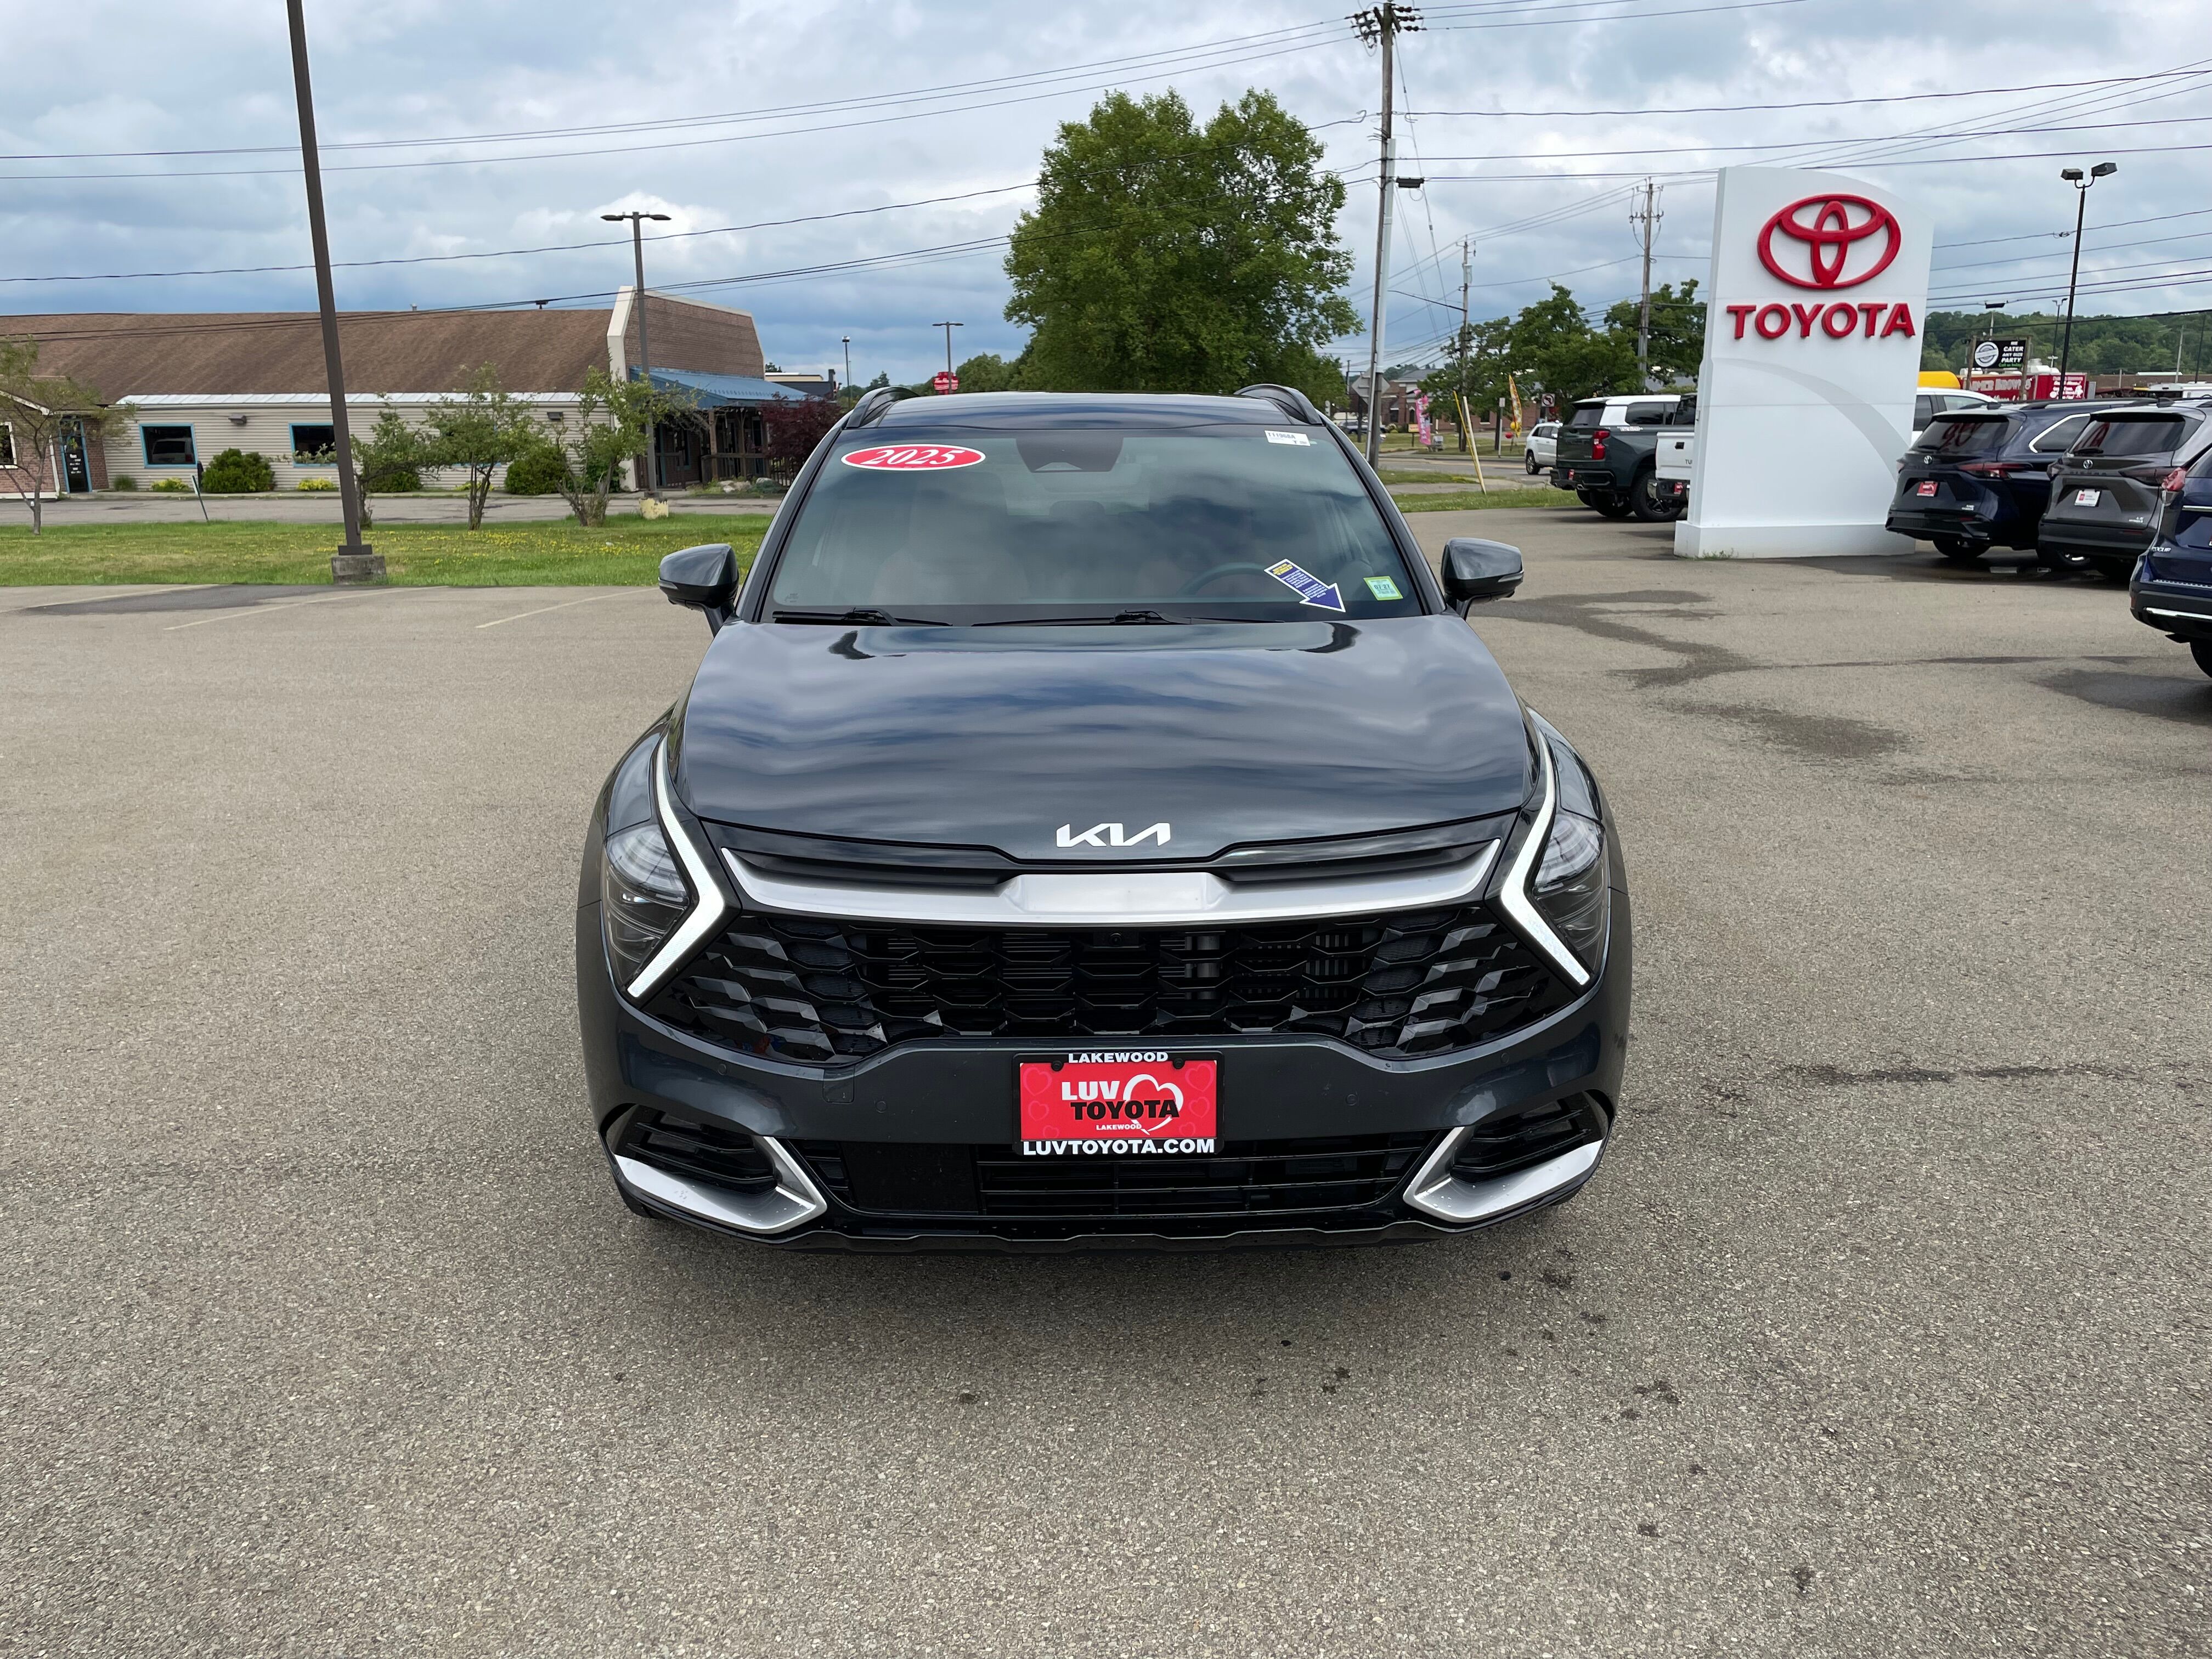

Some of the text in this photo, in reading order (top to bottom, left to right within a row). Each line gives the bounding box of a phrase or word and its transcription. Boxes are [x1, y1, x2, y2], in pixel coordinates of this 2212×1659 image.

[1726, 302, 1916, 340] TOYOTA
[860, 449, 966, 465] 2025
[1056, 823, 1171, 847] KIA
[1068, 1052, 1169, 1063] LAKEWOOD
[1062, 1081, 1120, 1101] LUV
[1070, 1099, 1180, 1120] TOYOTA
[1023, 1139, 1214, 1155] LUVTOYOTA.COM
